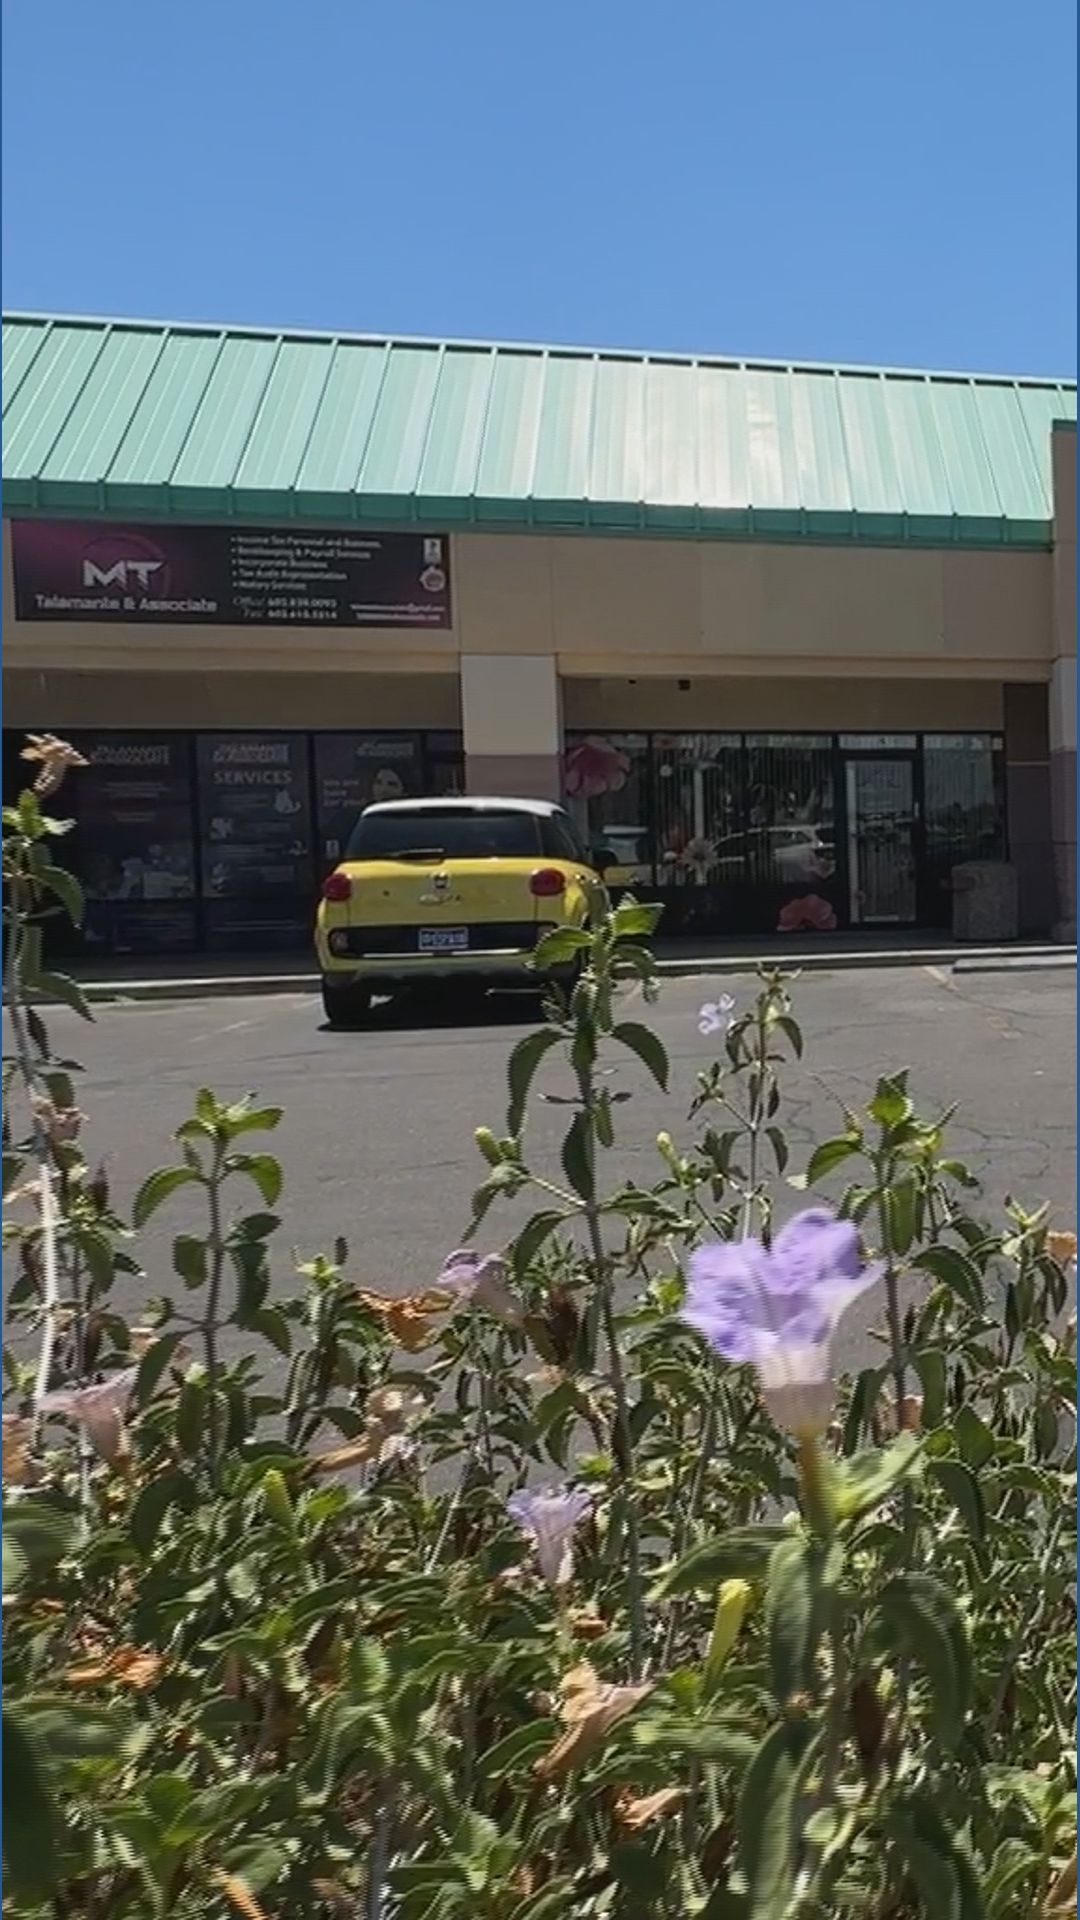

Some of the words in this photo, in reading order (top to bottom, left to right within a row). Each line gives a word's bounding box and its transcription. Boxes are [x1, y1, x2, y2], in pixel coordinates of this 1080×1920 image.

[82, 559, 164, 589] MT
[123, 597, 135, 610] &
[213, 770, 293, 785] SERVICES
